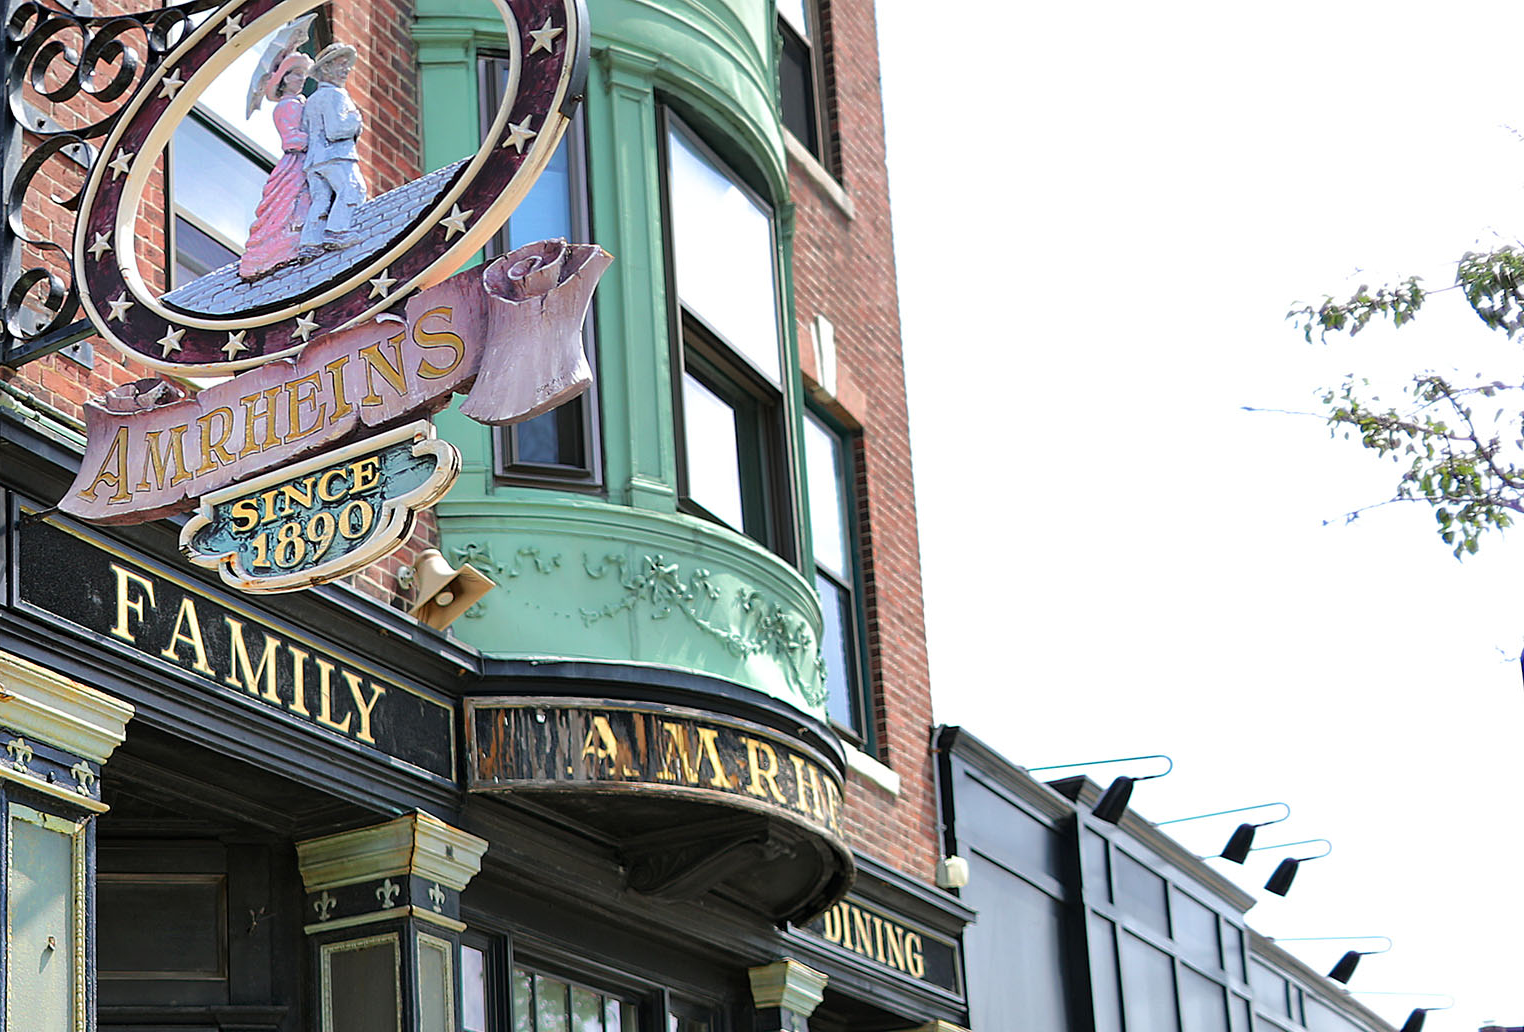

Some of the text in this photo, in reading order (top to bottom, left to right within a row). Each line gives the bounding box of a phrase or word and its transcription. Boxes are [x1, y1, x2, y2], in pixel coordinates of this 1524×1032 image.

[78, 305, 467, 504] AMRHEINS
[230, 455, 381, 532] SINCE
[251, 499, 374, 570] 1890
[109, 561, 386, 745] FAMILY
[823, 901, 925, 978] DINING
